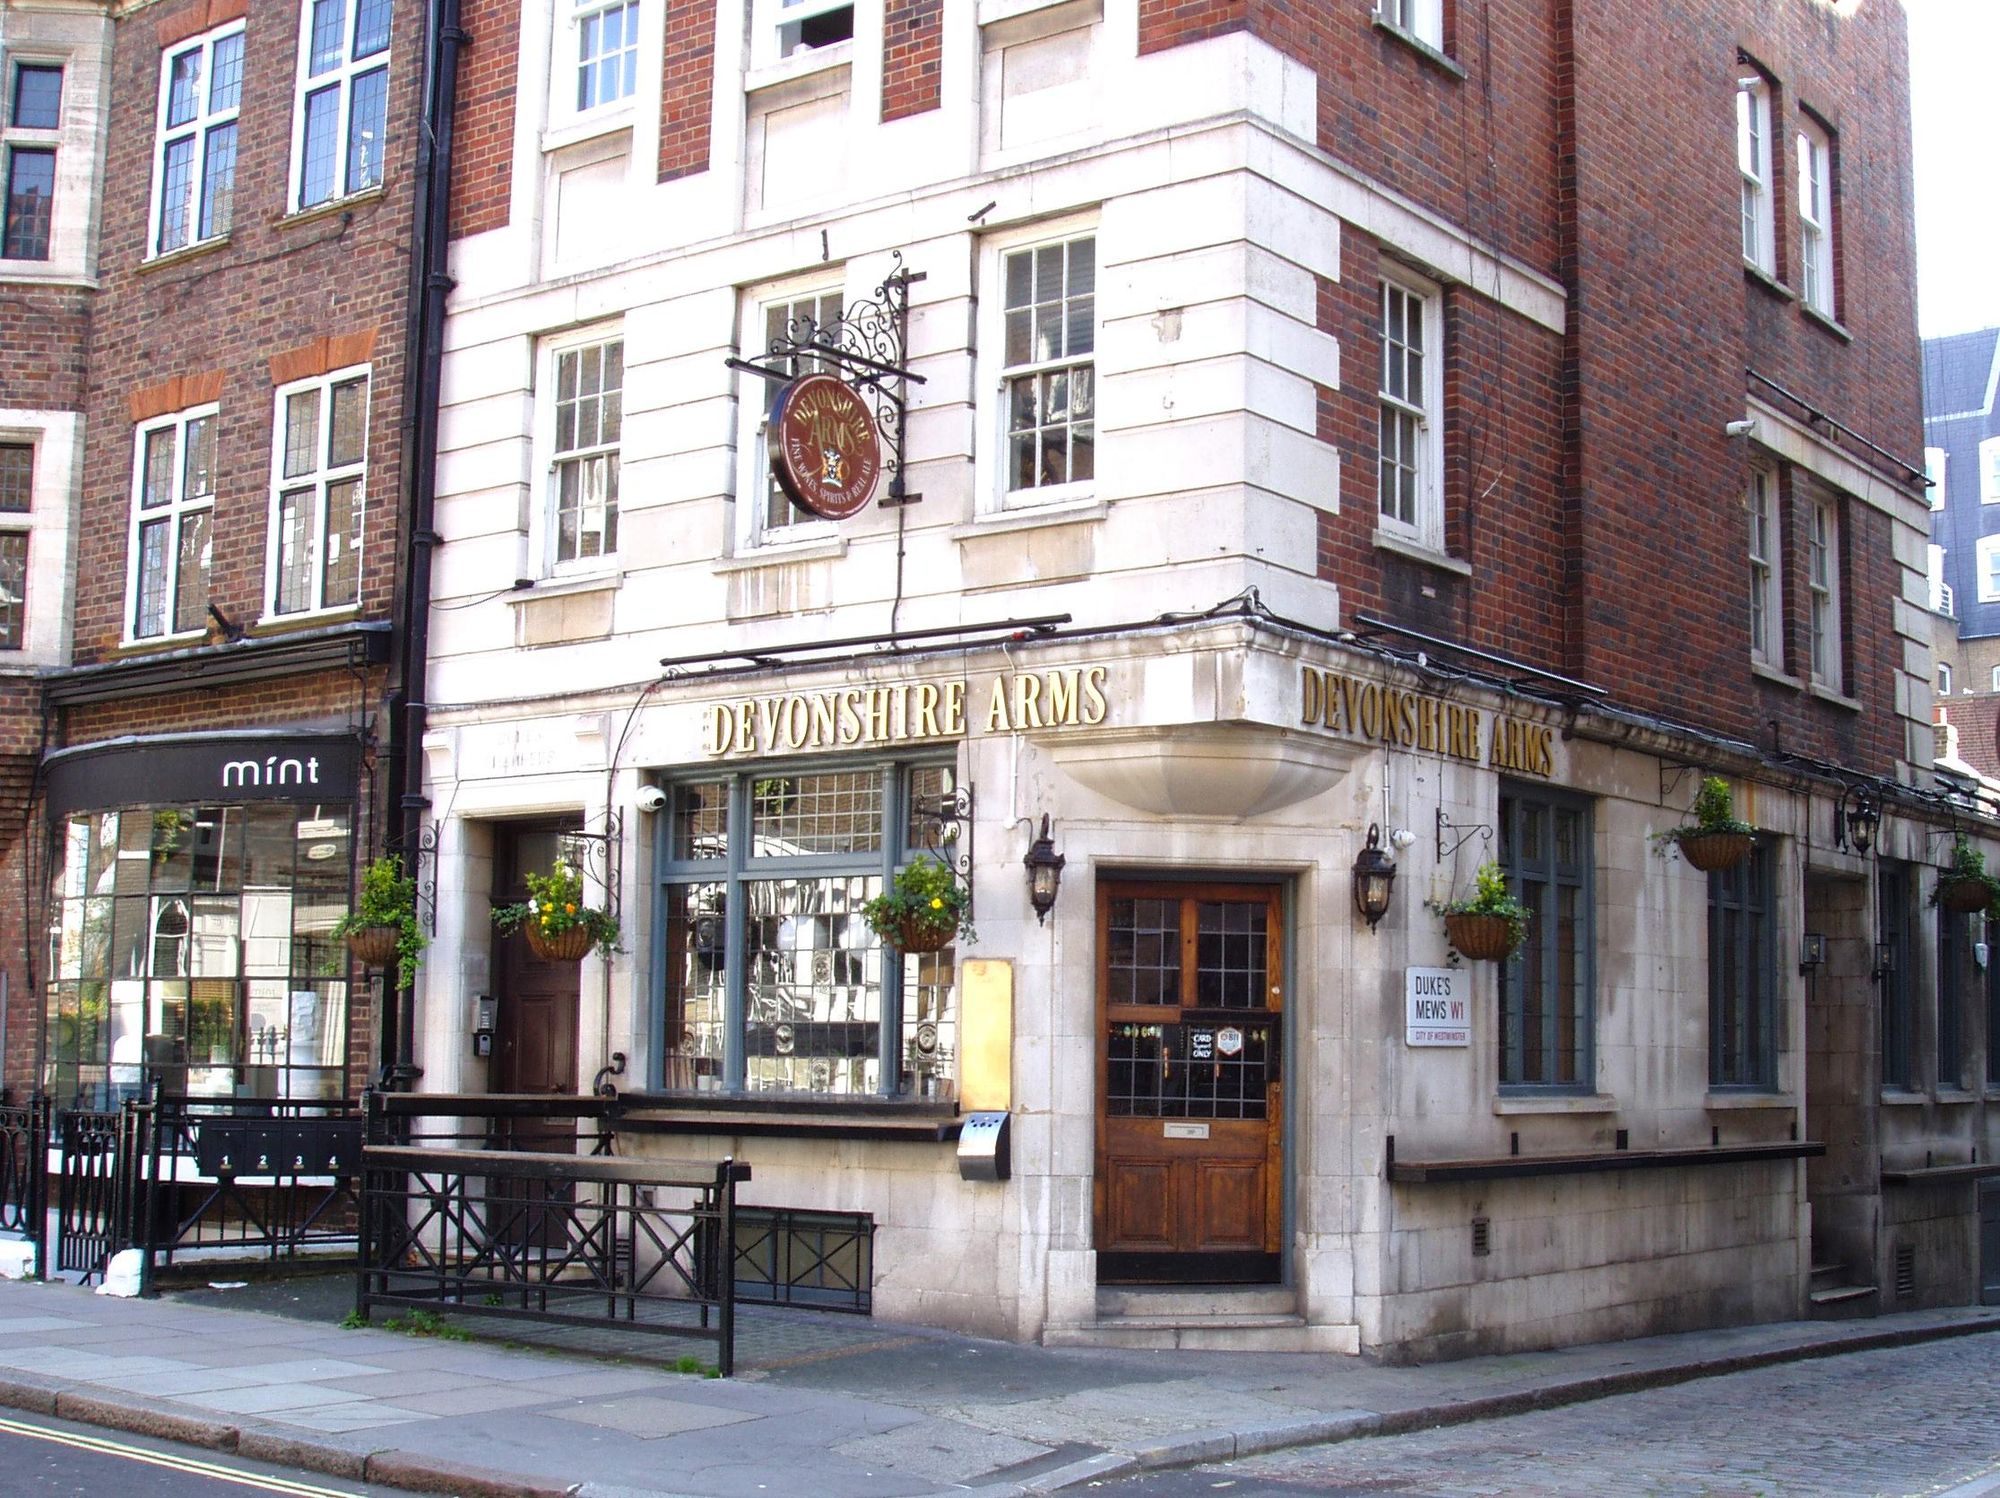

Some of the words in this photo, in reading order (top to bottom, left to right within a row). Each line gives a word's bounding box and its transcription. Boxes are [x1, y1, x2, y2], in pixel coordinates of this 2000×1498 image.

[792, 386, 871, 442] DEVONSHIRE
[807, 411, 858, 455] ARMS
[819, 487, 847, 504] SPIRITS
[707, 679, 967, 757] DEVONSHIRE
[984, 666, 1107, 733] ARMS
[1302, 665, 1481, 762] DEVONSHIRE
[1489, 714, 1553, 778] ARMS
[1415, 975, 1451, 996] DUKE'S
[1415, 1000, 1447, 1020] MEWS
[1450, 1001, 1464, 1020] W1
[1415, 1031, 1426, 1040] CITY
[1434, 1031, 1466, 1041] WESTMINSTER
[222, 1155, 229, 1165] 1
[259, 1155, 267, 1165] 2
[296, 1155, 303, 1165] 3
[329, 1156, 336, 1165] 4
